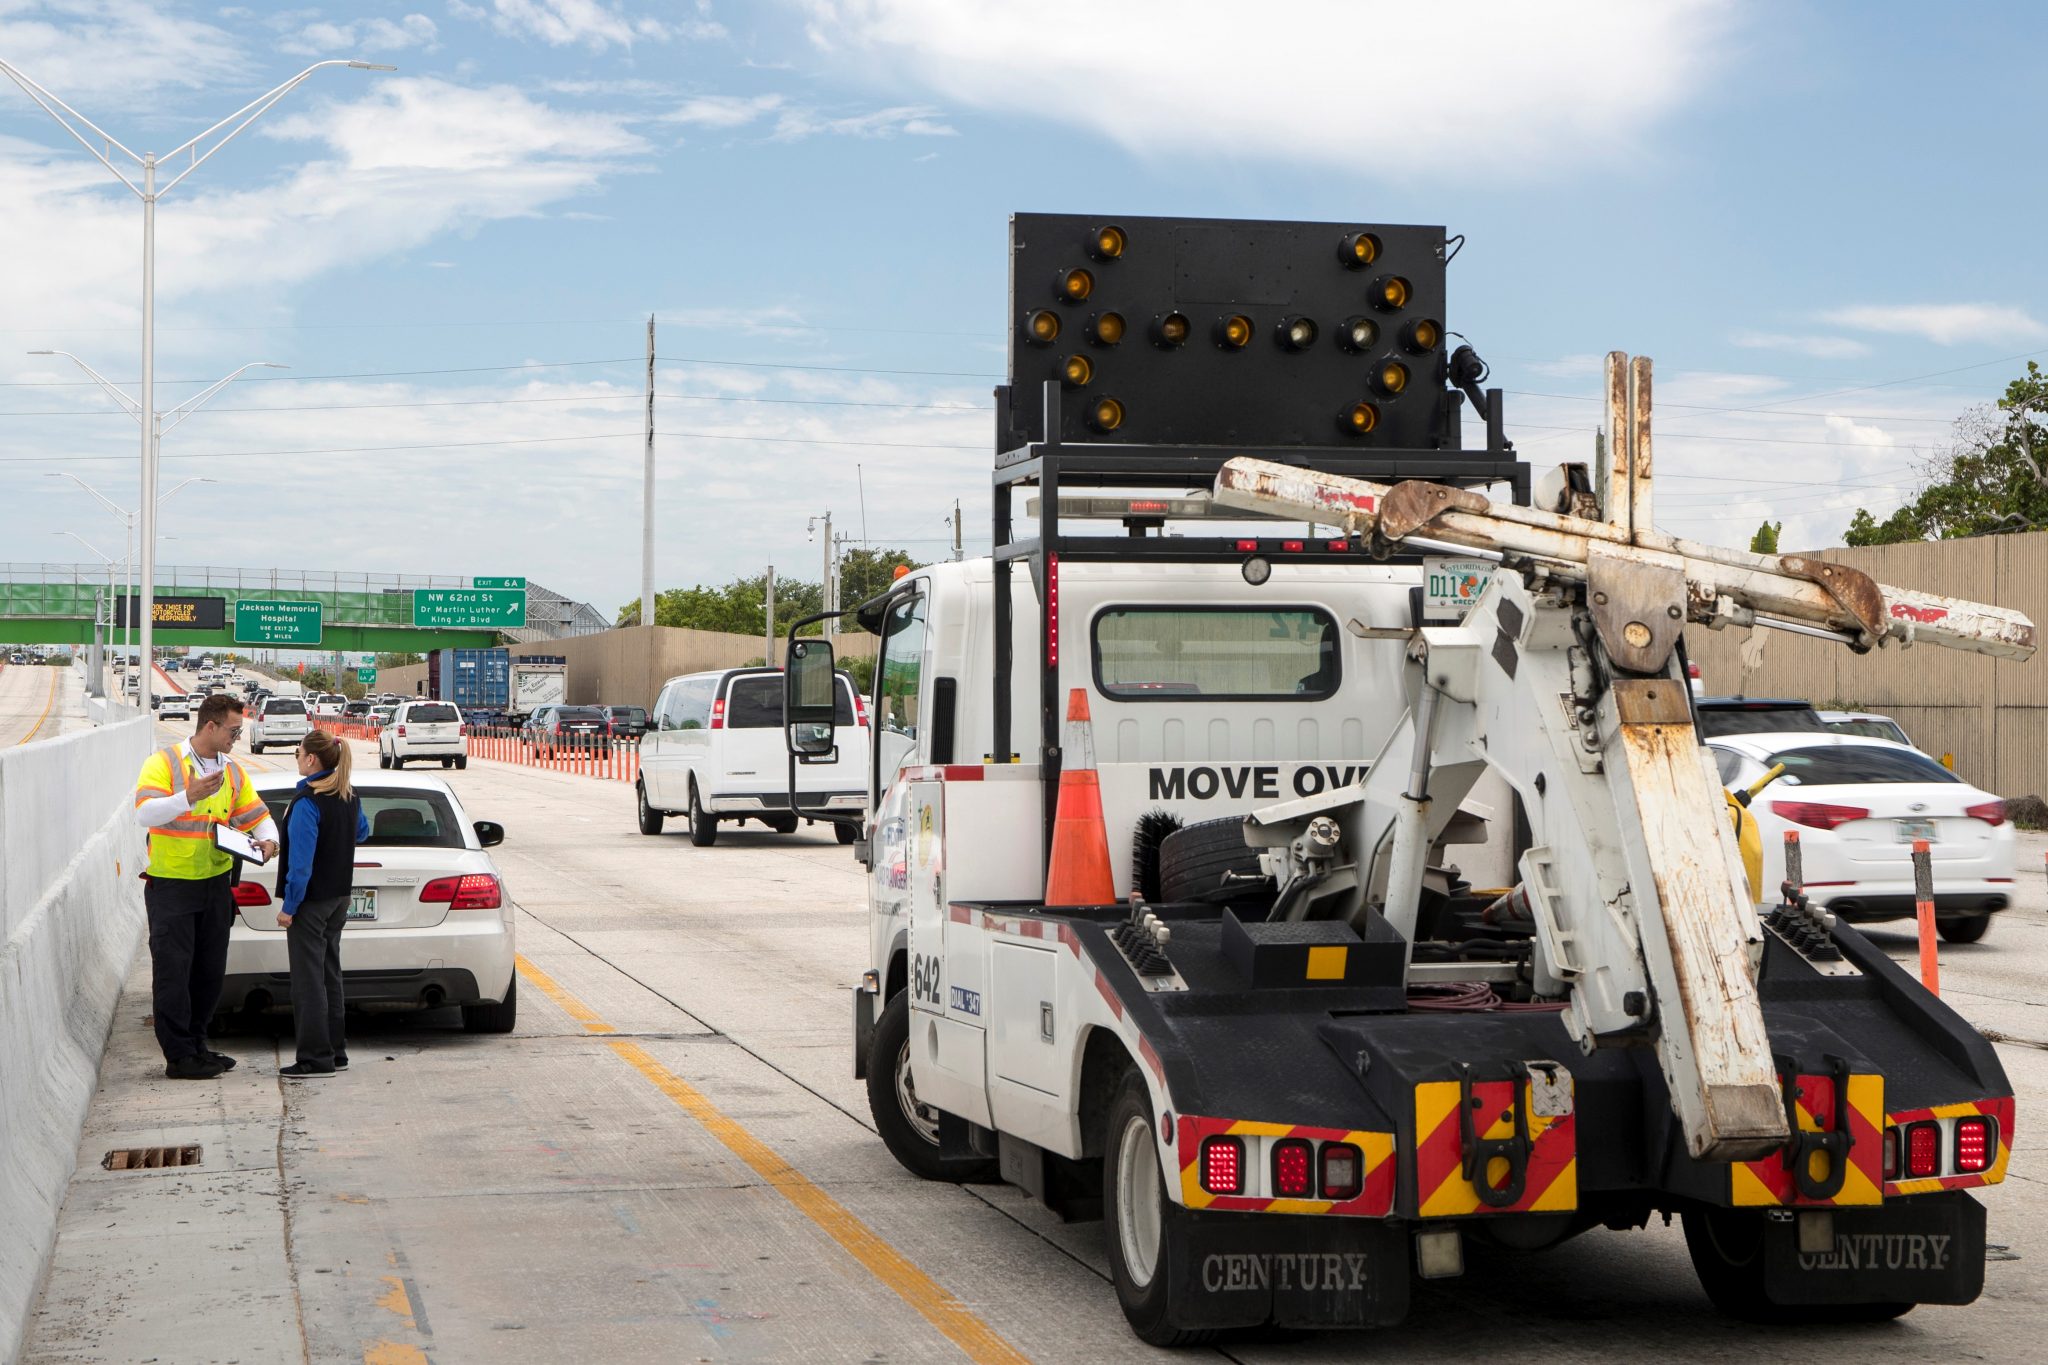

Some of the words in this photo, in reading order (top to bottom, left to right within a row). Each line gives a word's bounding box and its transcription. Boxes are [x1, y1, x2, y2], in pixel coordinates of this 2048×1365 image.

[504, 579, 518, 587] 6A
[1430, 575, 1458, 597] D11
[428, 593, 444, 602] NW
[449, 593, 476, 602] 62nd
[482, 593, 493, 602] St
[278, 605, 318, 613] Memorial
[261, 614, 297, 623] Hospital
[431, 616, 451, 624] King
[1149, 766, 1280, 800] MOVE
[1293, 766, 1371, 798] OV
[353, 897, 374, 912] T74
[915, 952, 940, 1005] 642
[951, 988, 965, 1010] DIAL
[1202, 1253, 1368, 1293] CENTURY
